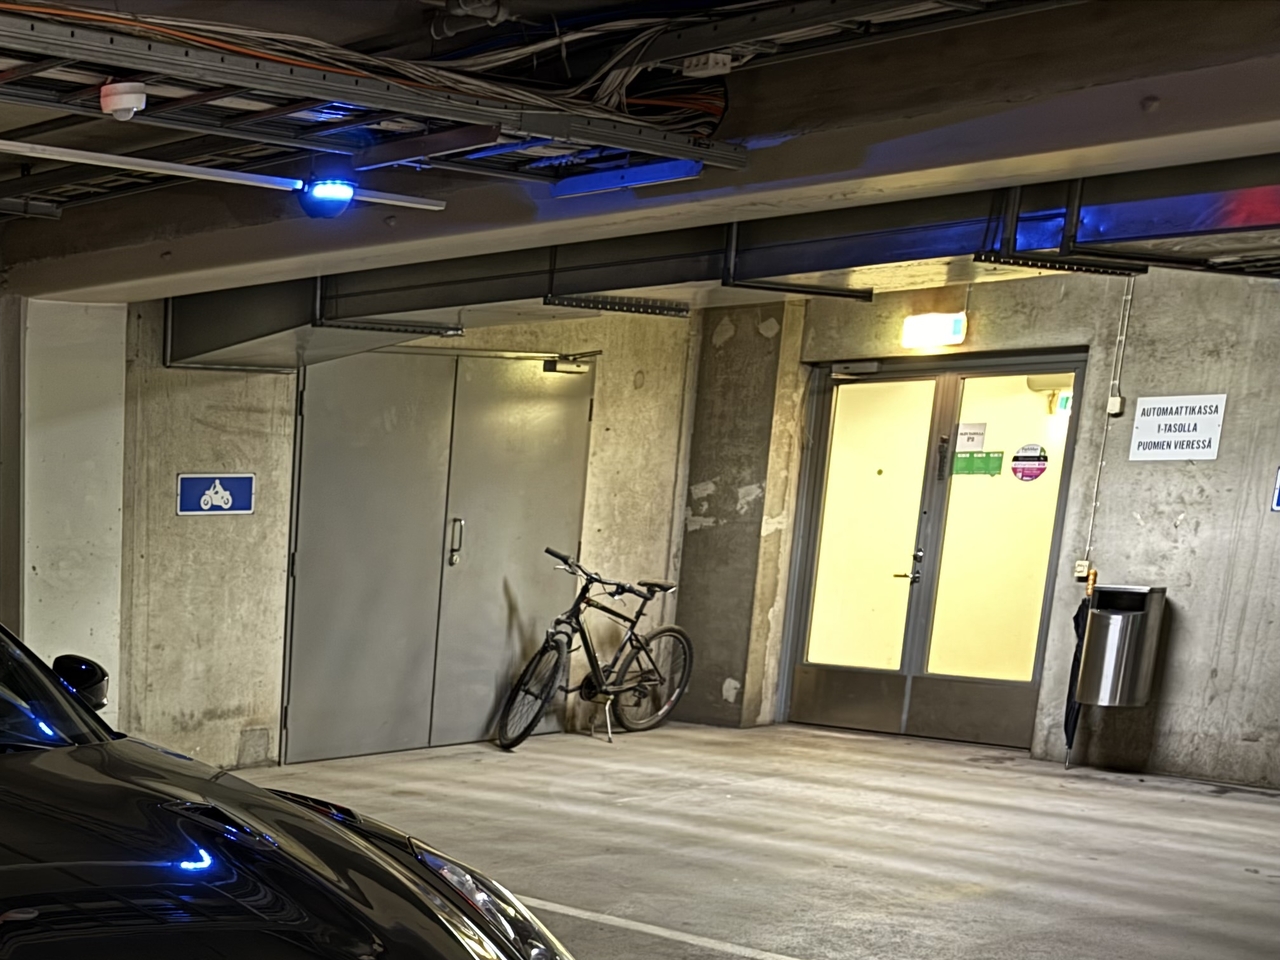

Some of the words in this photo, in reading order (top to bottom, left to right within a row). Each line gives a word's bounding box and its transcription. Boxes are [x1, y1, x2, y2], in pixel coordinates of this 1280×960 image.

[1140, 404, 1219, 418] AUTOMAATTIKASSA
[1137, 440, 1172, 451] PUOMIEN
[1173, 437, 1213, 450] VIERESSÄ
